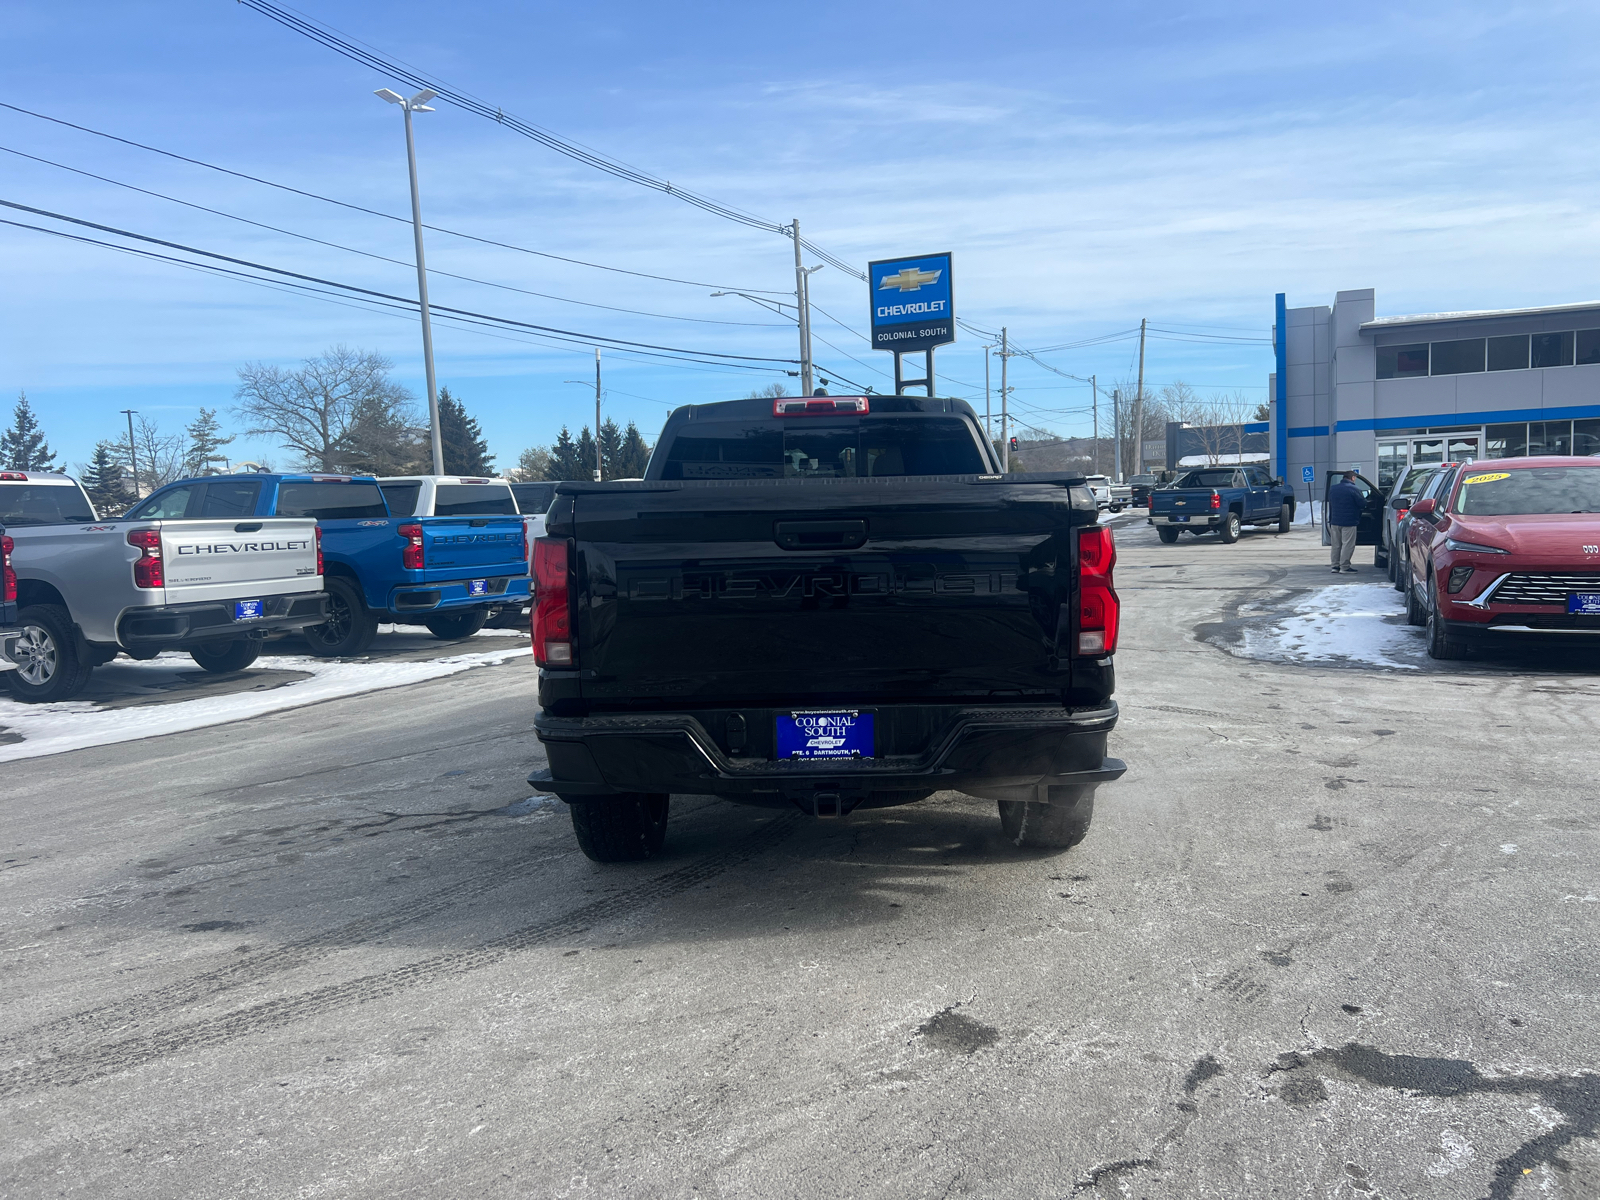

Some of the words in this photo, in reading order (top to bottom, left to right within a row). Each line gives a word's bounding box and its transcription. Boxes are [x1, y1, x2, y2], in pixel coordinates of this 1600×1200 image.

[878, 300, 946, 317] CHEVROLET
[877, 330, 917, 342] COLONIAL
[919, 327, 947, 337] SOUTH
[1471, 473, 1502, 483] 2025
[434, 534, 521, 544] CHEVROLET
[178, 540, 310, 555] CHEVROLET
[627, 568, 1019, 601] CHEVROLET
[796, 717, 855, 727] COLONIAL
[805, 727, 846, 736] SOUTH
